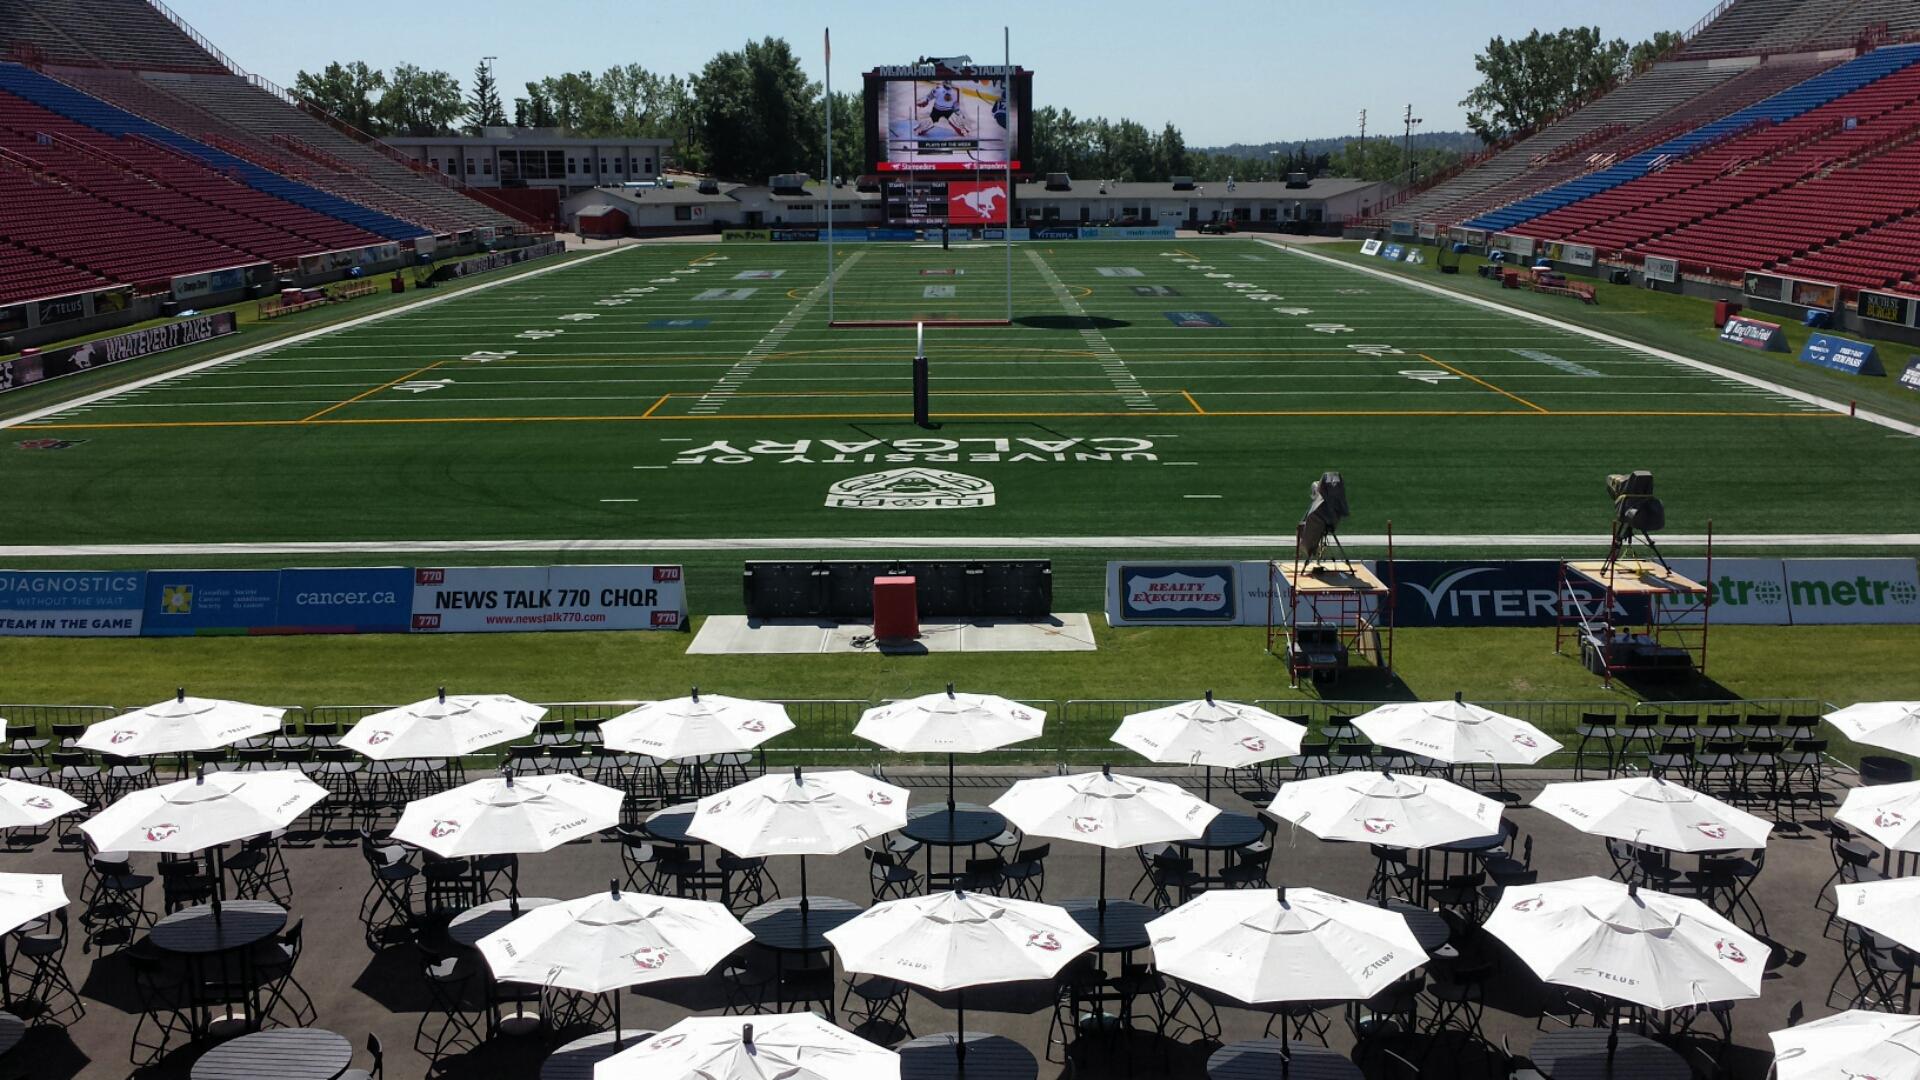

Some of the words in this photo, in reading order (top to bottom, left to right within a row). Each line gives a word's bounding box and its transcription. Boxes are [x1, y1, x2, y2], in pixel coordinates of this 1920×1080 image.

[55, 300, 82, 314] TELUS
[106, 330, 168, 362] WHATEVER
[168, 324, 180, 346] IT
[182, 317, 212, 343] TAKES
[678, 437, 1154, 455] CALGARY
[672, 454, 754, 464] OF
[779, 452, 1158, 464] UNIVERSITY
[422, 570, 442, 582] 770
[659, 568, 679, 579] 770
[0, 576, 138, 592] DIAGNOSTICS
[1148, 582, 1206, 592] REALTY
[296, 589, 396, 607] cancer.ca
[435, 590, 498, 609] NEWS
[503, 588, 553, 609] TALK
[558, 588, 590, 607] 770
[600, 588, 658, 608] CHQR
[1132, 590, 1222, 605] EXECUTIVES
[1401, 567, 1629, 619] VITERRA
[16, 596, 68, 606] WITHOUT
[71, 596, 93, 606] THE
[96, 596, 124, 606] WAIT
[40, 619, 56, 629] IN
[60, 619, 88, 629] THE
[91, 618, 133, 629] GAME
[418, 615, 439, 627] 770
[486, 612, 606, 625] www.newstalk770.com
[657, 612, 676, 624] 770
[1597, 970, 1641, 986] TELUS
